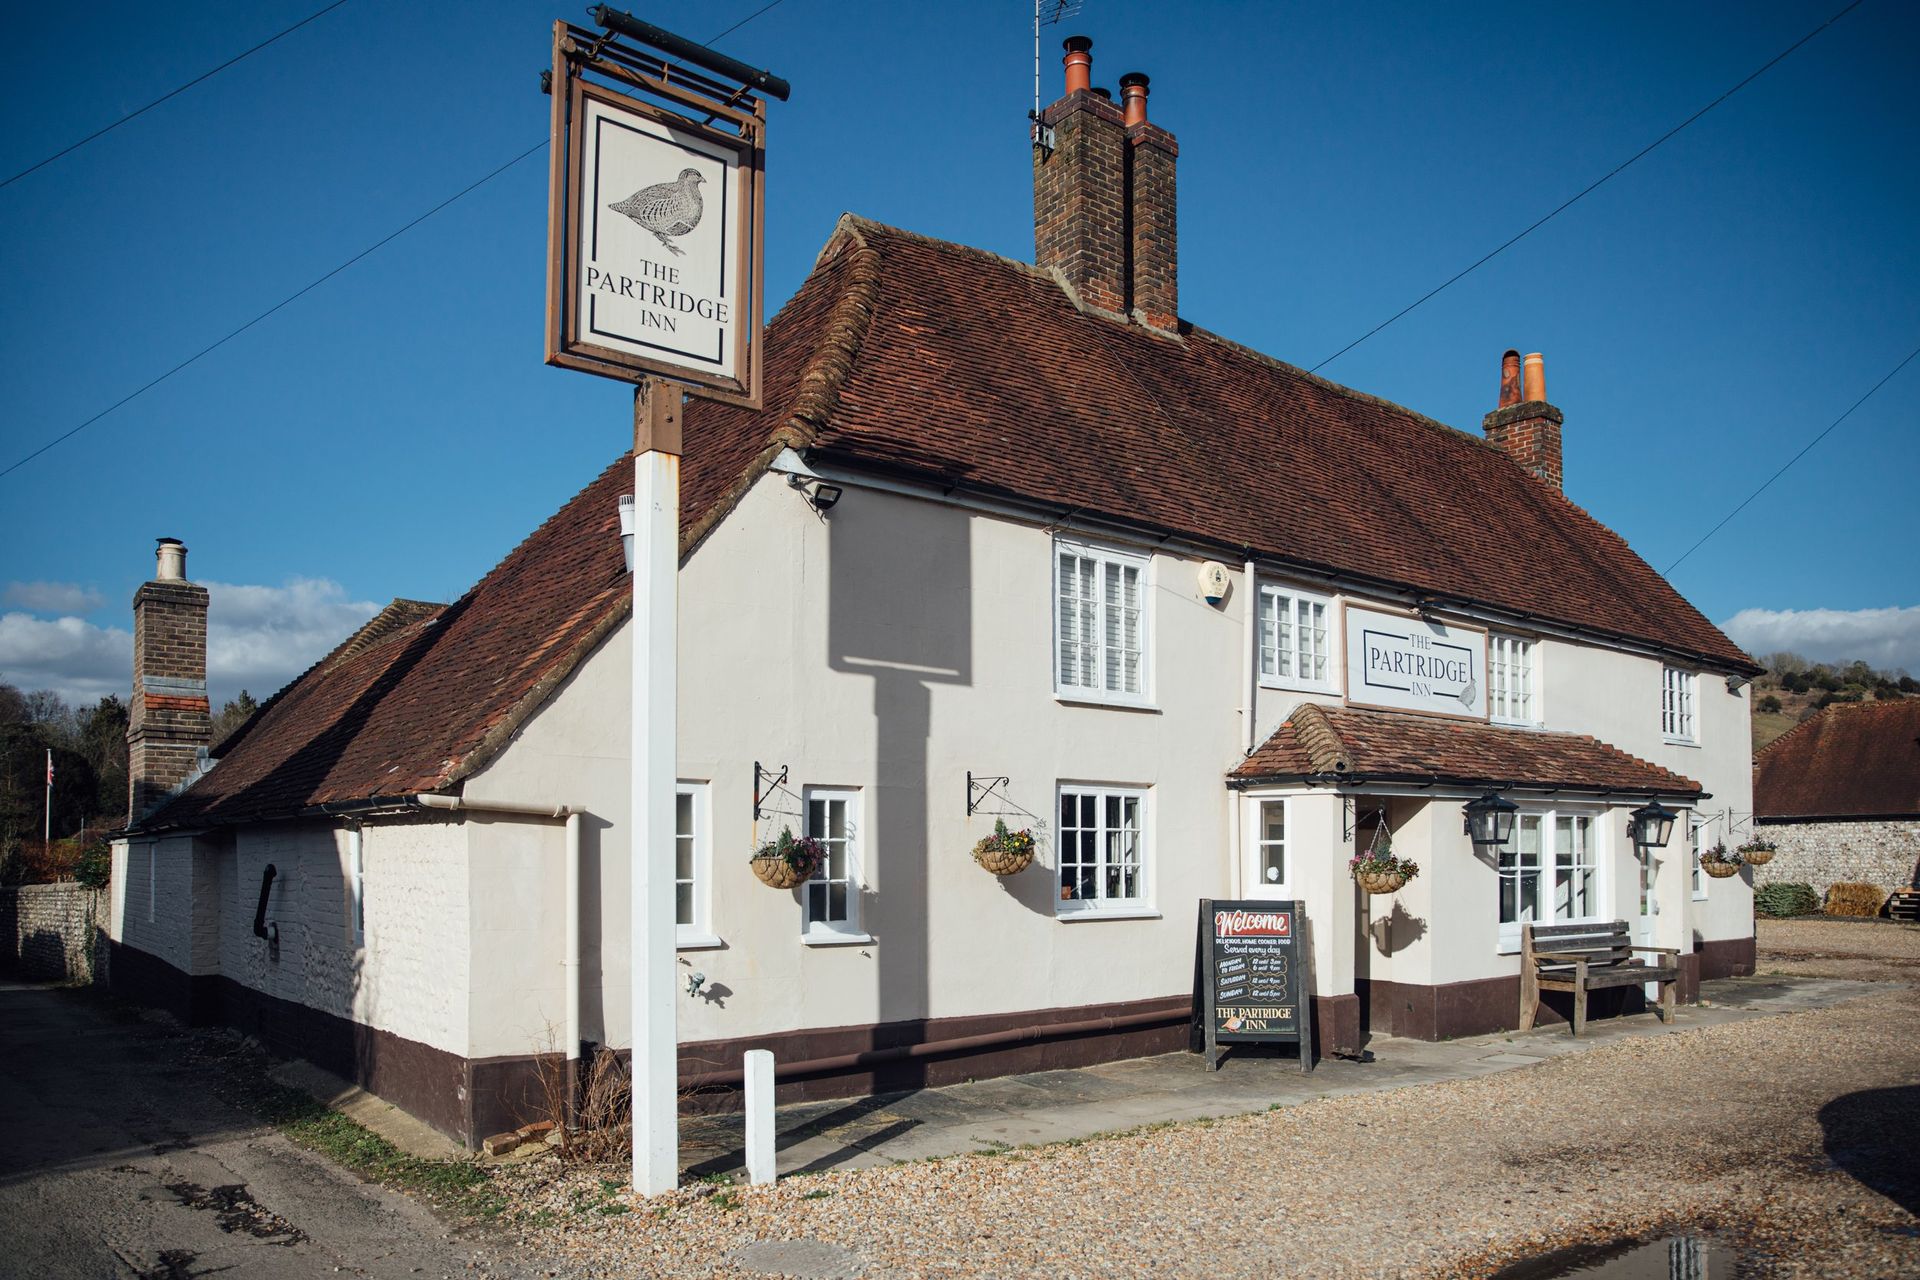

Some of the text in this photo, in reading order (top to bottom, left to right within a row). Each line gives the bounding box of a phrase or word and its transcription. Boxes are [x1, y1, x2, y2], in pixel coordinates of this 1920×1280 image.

[640, 259, 680, 285] THE
[586, 266, 729, 324] PARTRIDGE
[640, 309, 676, 333] INN
[1409, 633, 1431, 650] THE
[1370, 647, 1468, 683] PARTRIDGE
[1412, 681, 1431, 697] INN
[1215, 910, 1287, 938] Welcome
[1224, 944, 1281, 956] Served every day
[1219, 958, 1242, 968] MONDAY
[1220, 974, 1246, 986] SATURDAY
[1219, 988, 1243, 1000] SUNDAY
[1216, 1007, 1292, 1019] THE PARTRIDGE
[1245, 1020, 1267, 1030] INN
